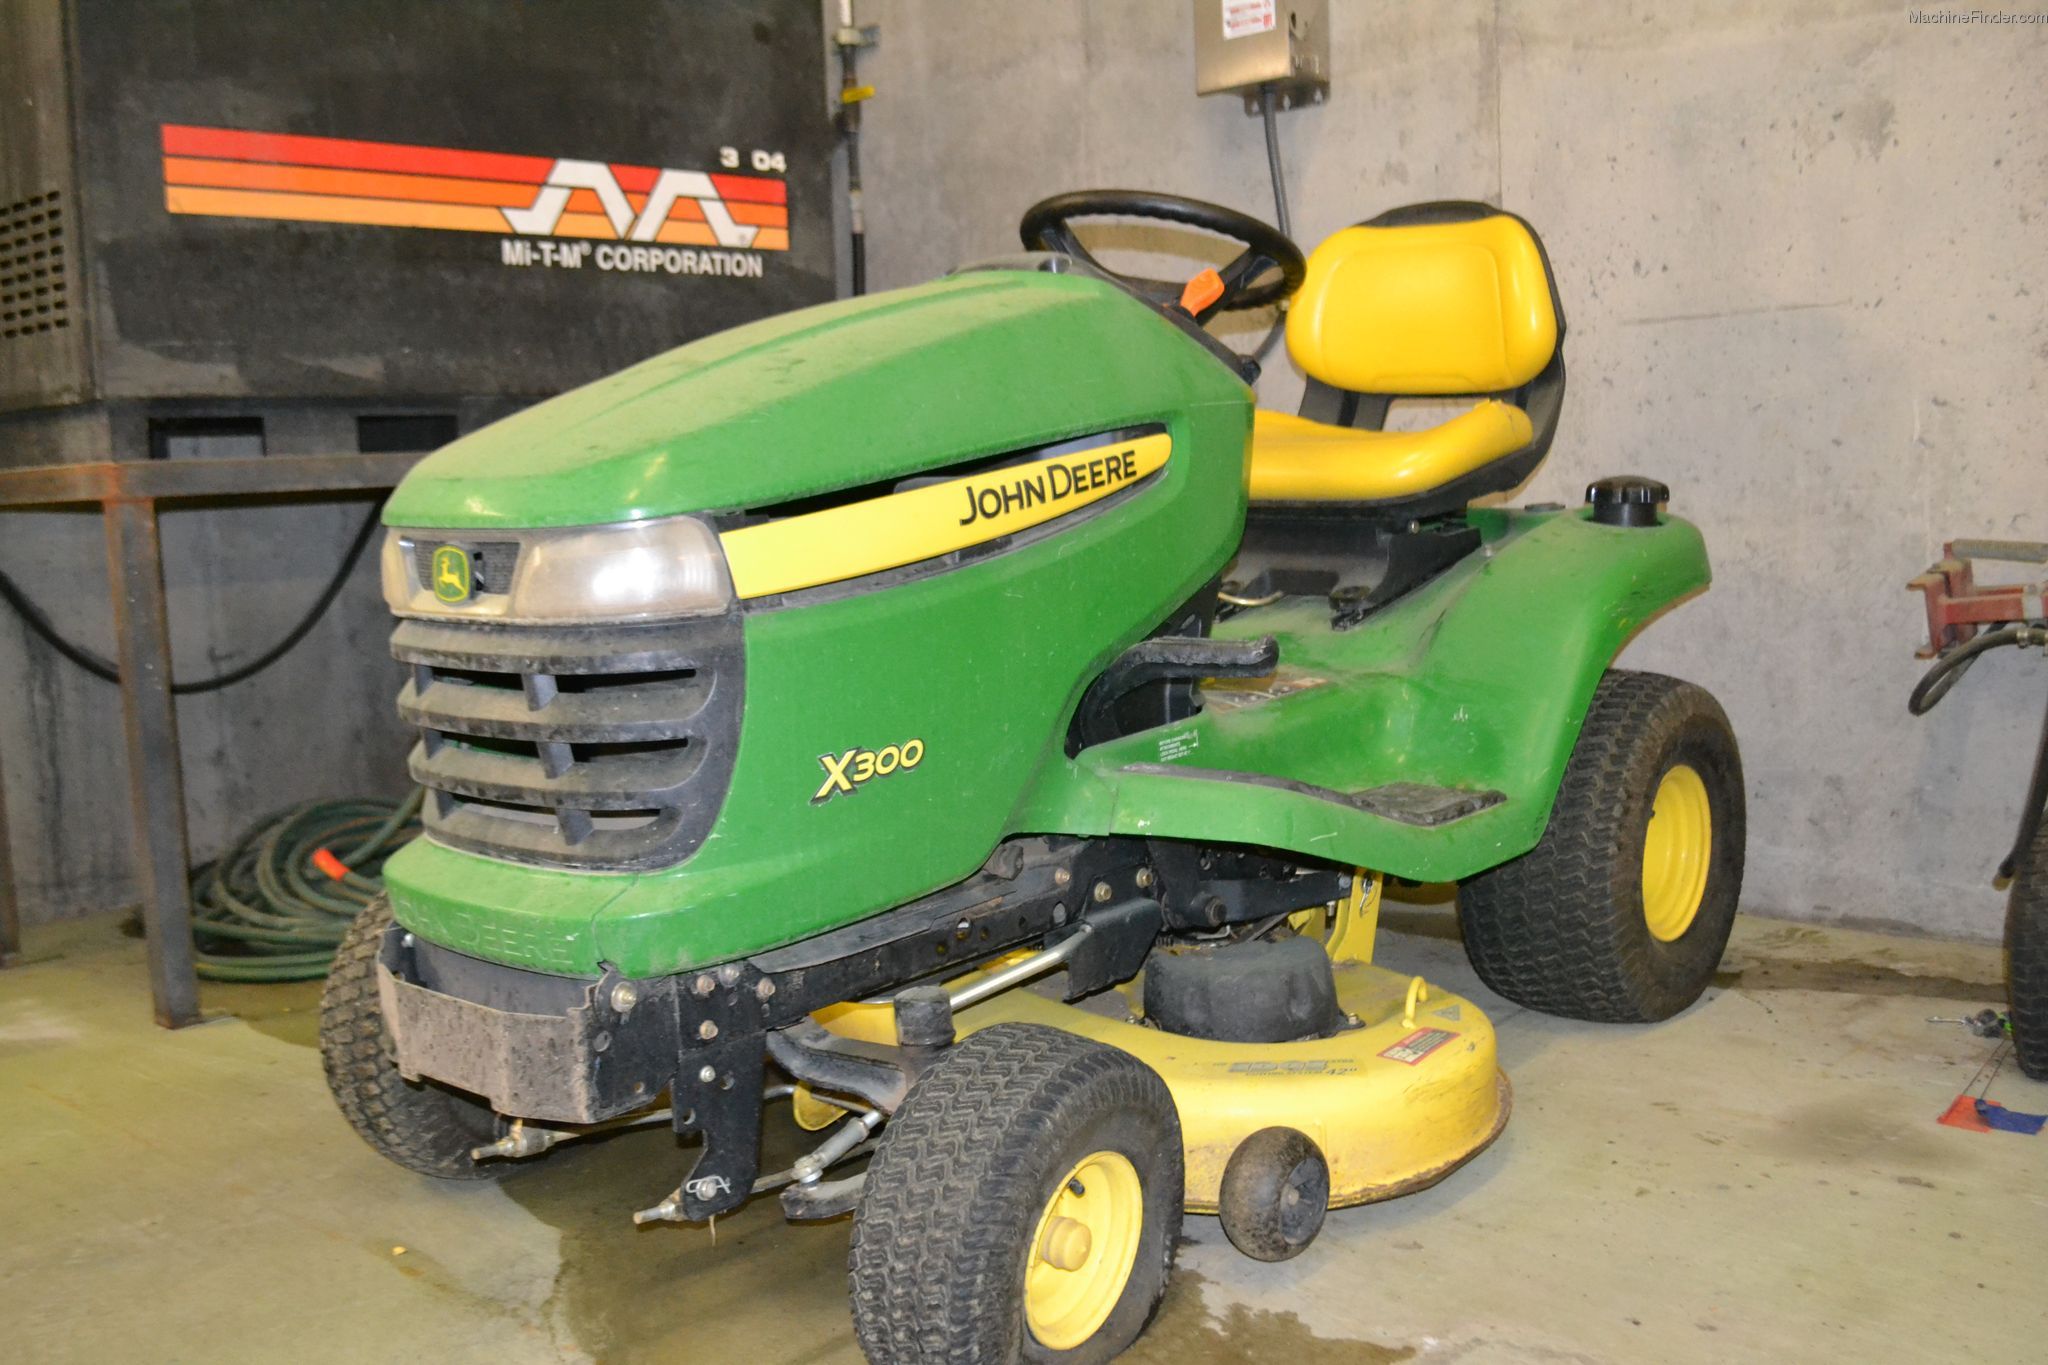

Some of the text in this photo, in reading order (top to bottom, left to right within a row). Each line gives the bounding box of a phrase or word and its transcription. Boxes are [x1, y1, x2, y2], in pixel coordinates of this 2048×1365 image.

[595, 247, 763, 278] CORPORATION
[959, 449, 1137, 526] JOHN DEERE
[810, 739, 924, 804] X300
